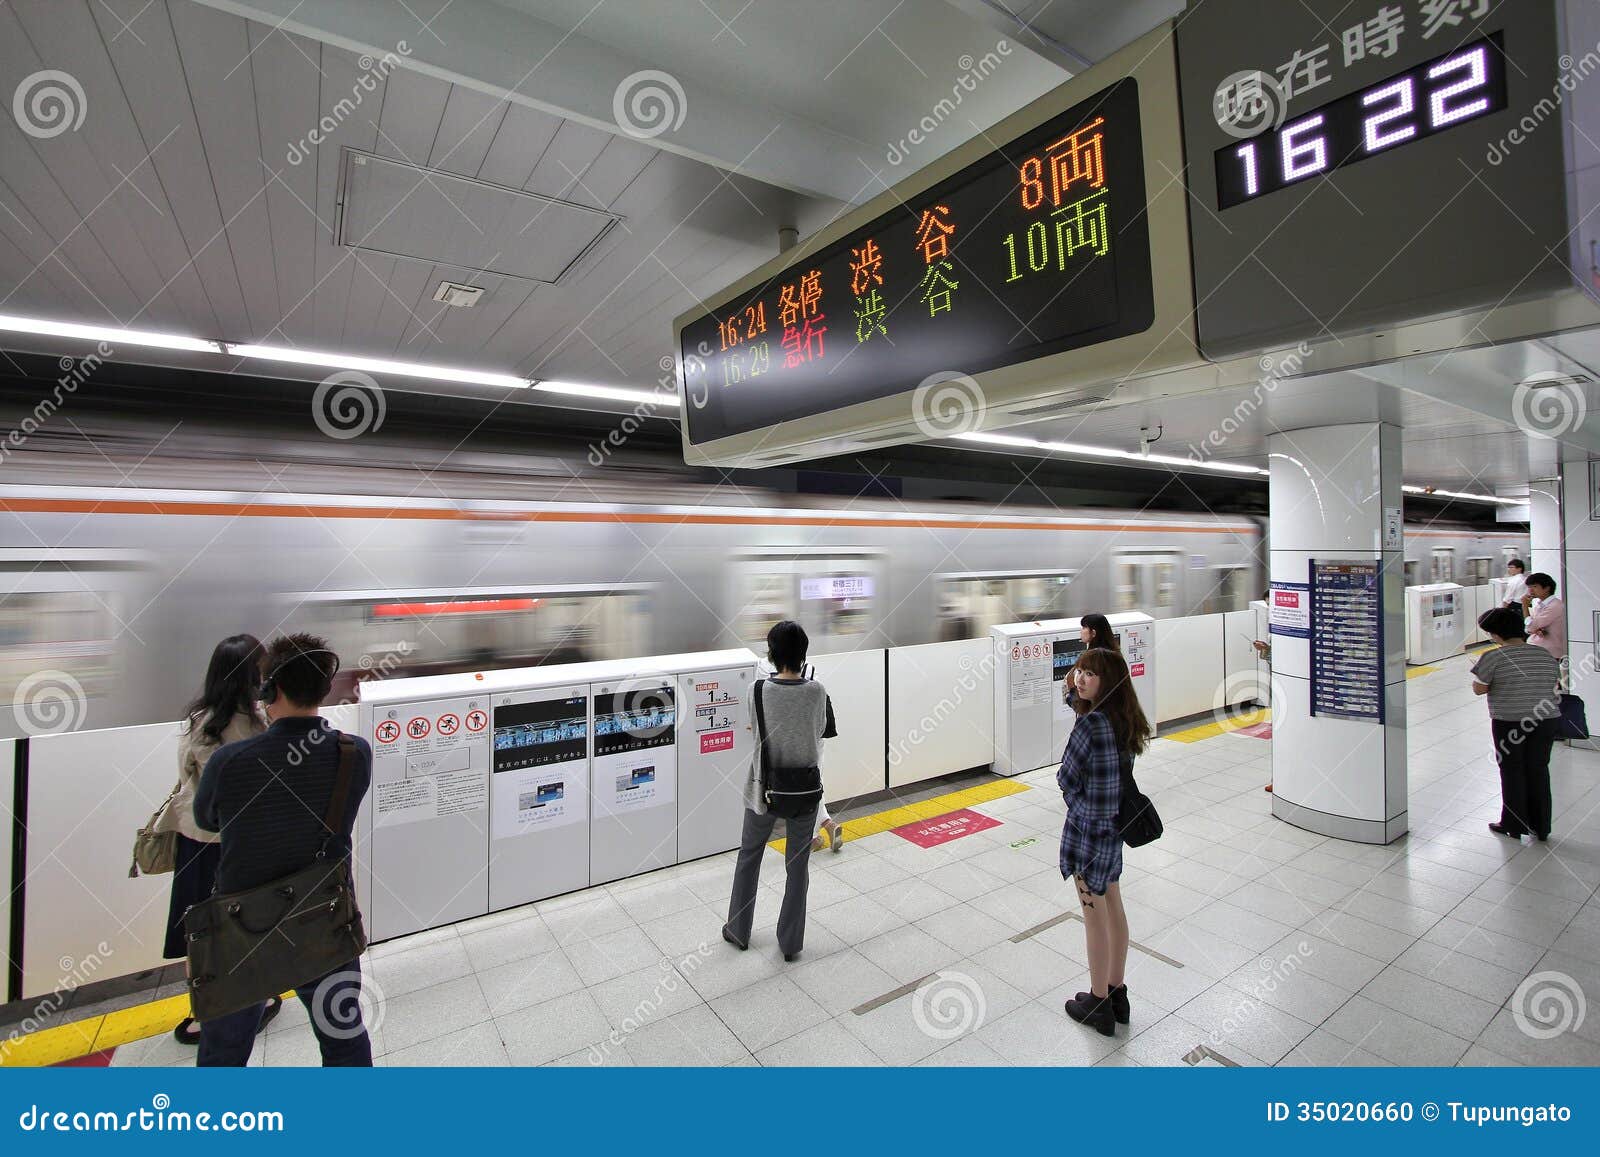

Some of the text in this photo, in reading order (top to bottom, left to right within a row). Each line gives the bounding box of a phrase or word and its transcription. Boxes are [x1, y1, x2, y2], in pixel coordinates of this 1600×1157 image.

[1237, 47, 1488, 195] 16 22
[718, 301, 767, 352] 16:24
[778, 270, 823, 328] 各停
[1020, 117, 1104, 210] 8両
[721, 341, 769, 387] 16:29
[780, 314, 828, 369] 急行
[1003, 187, 1108, 282] 10両
